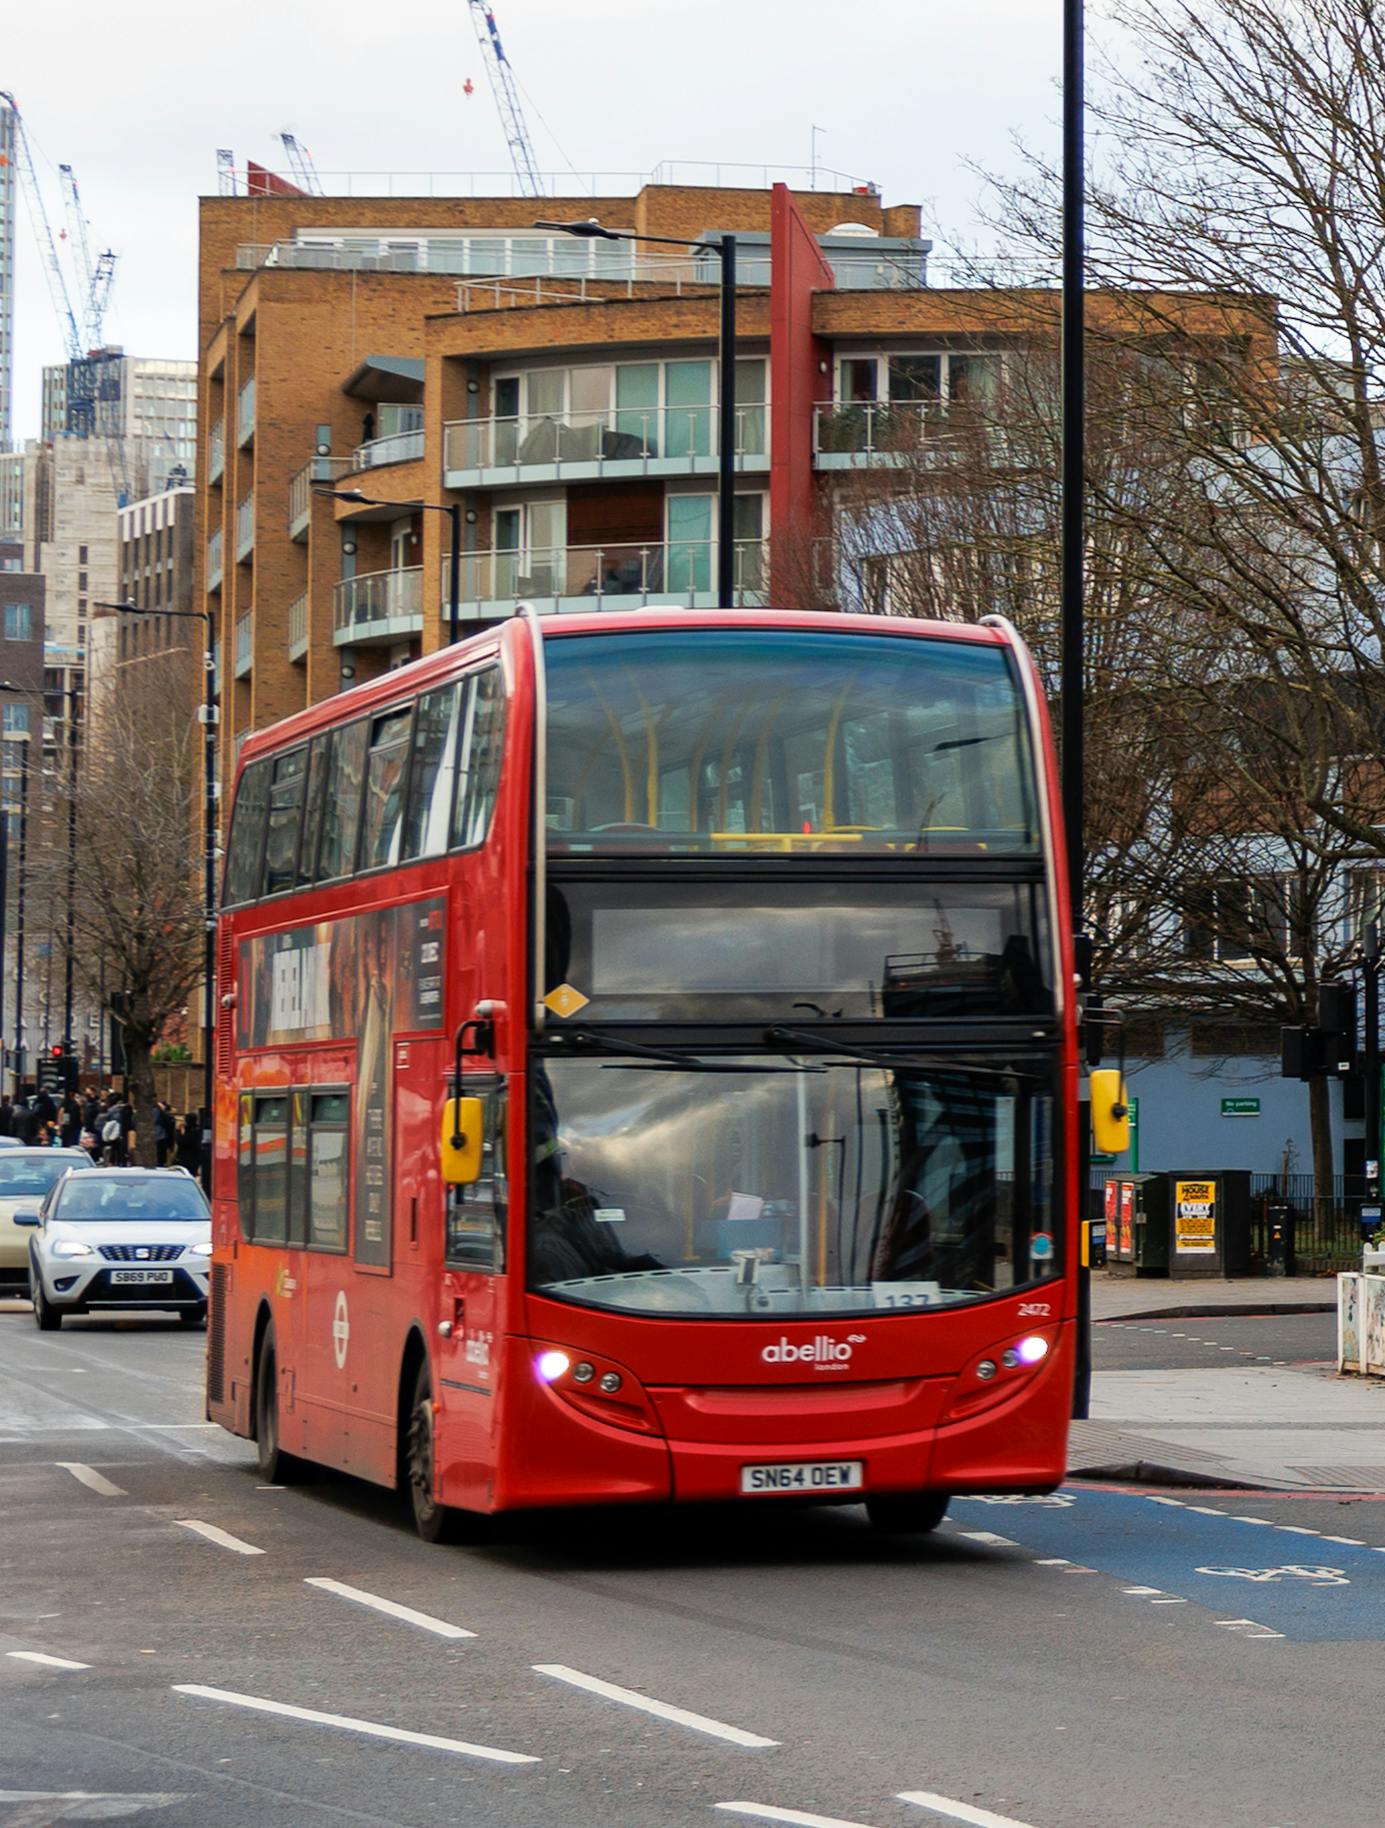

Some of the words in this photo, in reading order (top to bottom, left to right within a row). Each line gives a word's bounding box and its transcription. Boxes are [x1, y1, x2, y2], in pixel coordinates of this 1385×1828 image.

[885, 1294, 930, 1306] 137
[1017, 1303, 1051, 1317] 2472
[762, 1335, 852, 1363] abellio
[751, 1468, 805, 1488] SN64
[811, 1466, 852, 1486] OEW
